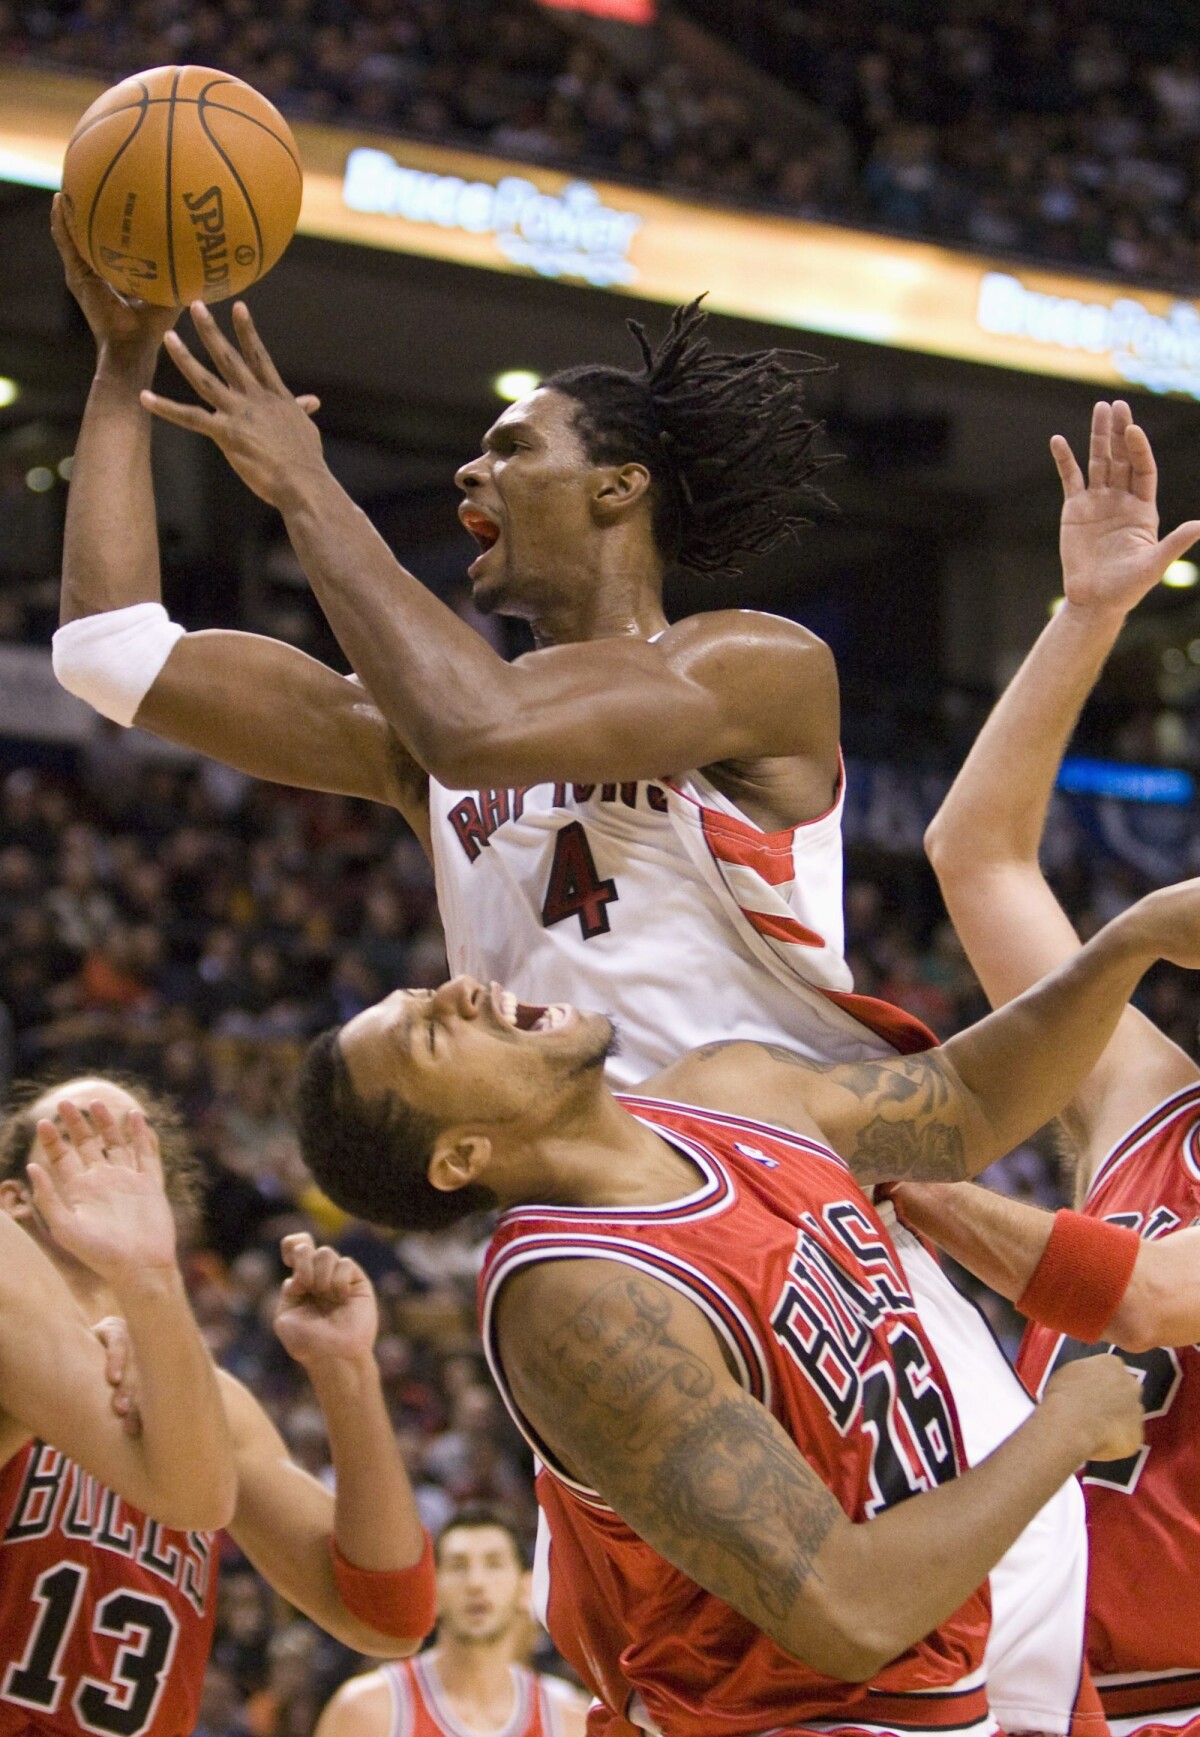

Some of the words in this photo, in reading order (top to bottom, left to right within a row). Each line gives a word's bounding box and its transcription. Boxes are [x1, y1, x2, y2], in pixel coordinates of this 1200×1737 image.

[182, 185, 232, 298] SPALD
[542, 820, 620, 941] 4
[769, 1200, 918, 1438] BULS
[859, 1320, 962, 1521] 16
[2, 1437, 214, 1619] BULLS
[0, 1559, 181, 1737] 13
